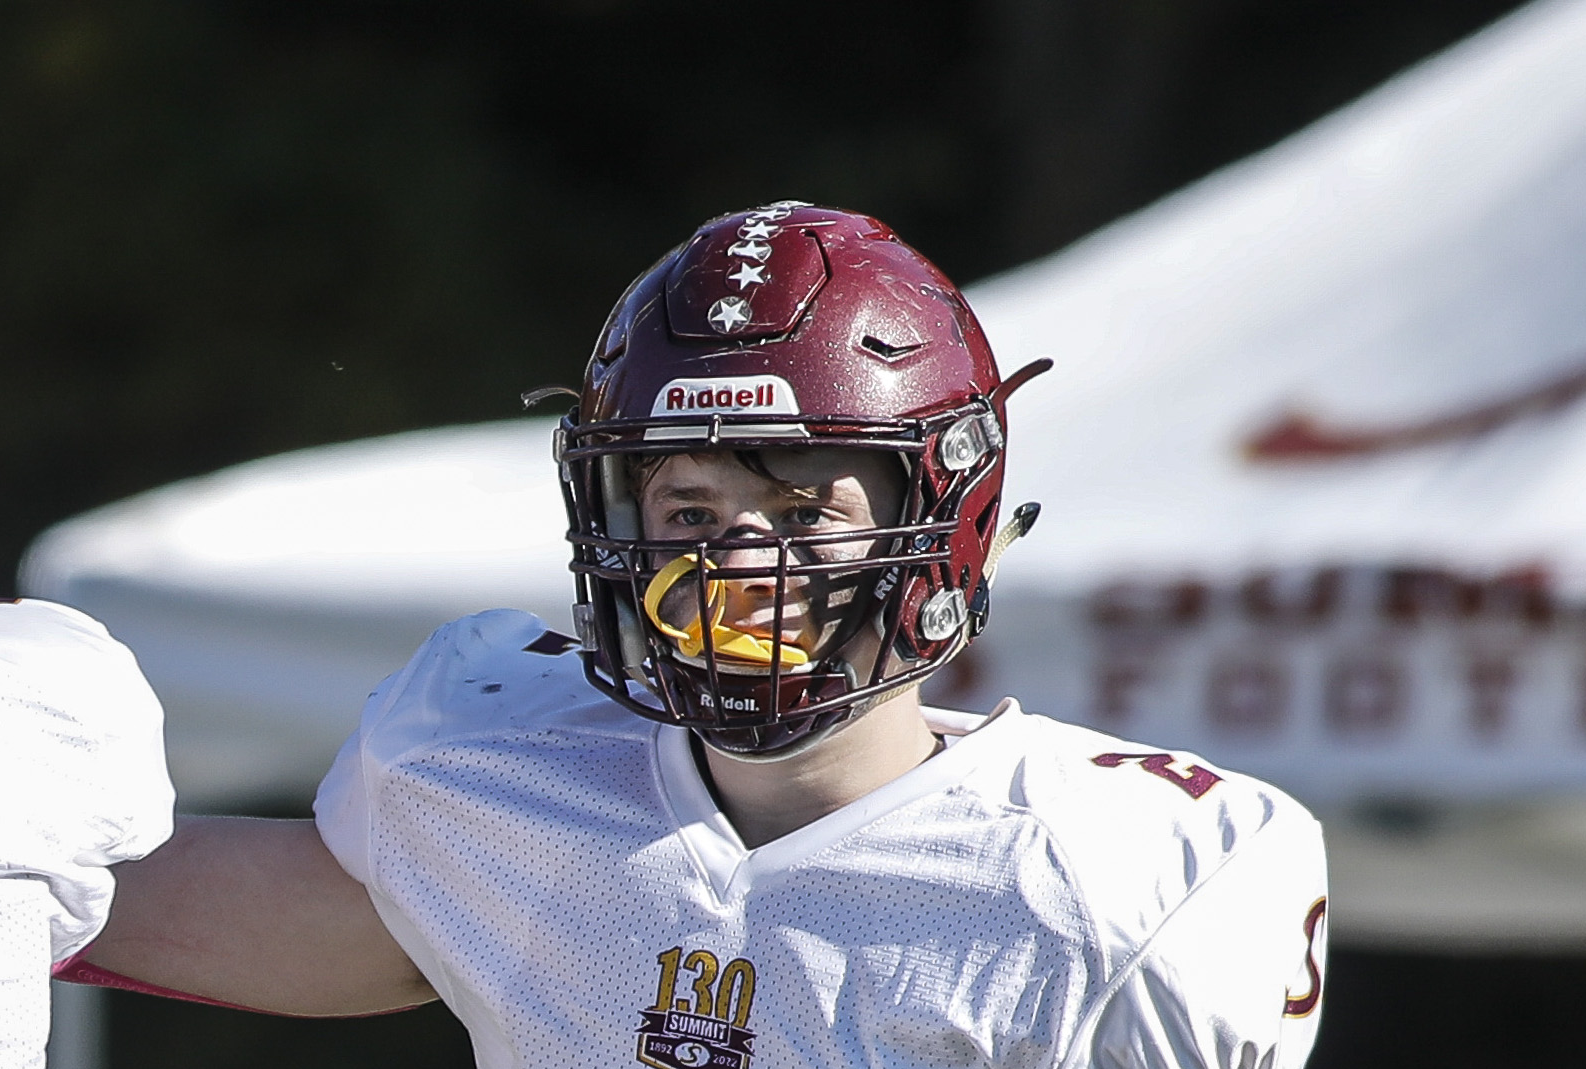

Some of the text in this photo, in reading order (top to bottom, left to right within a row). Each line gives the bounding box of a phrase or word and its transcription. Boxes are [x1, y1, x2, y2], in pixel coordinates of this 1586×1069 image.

[666, 384, 774, 411] Riddell
[1092, 660, 1586, 738] FOOT
[645, 945, 757, 1031] 130
[668, 1013, 729, 1041] SUMMIT
[649, 1041, 673, 1055] 1892
